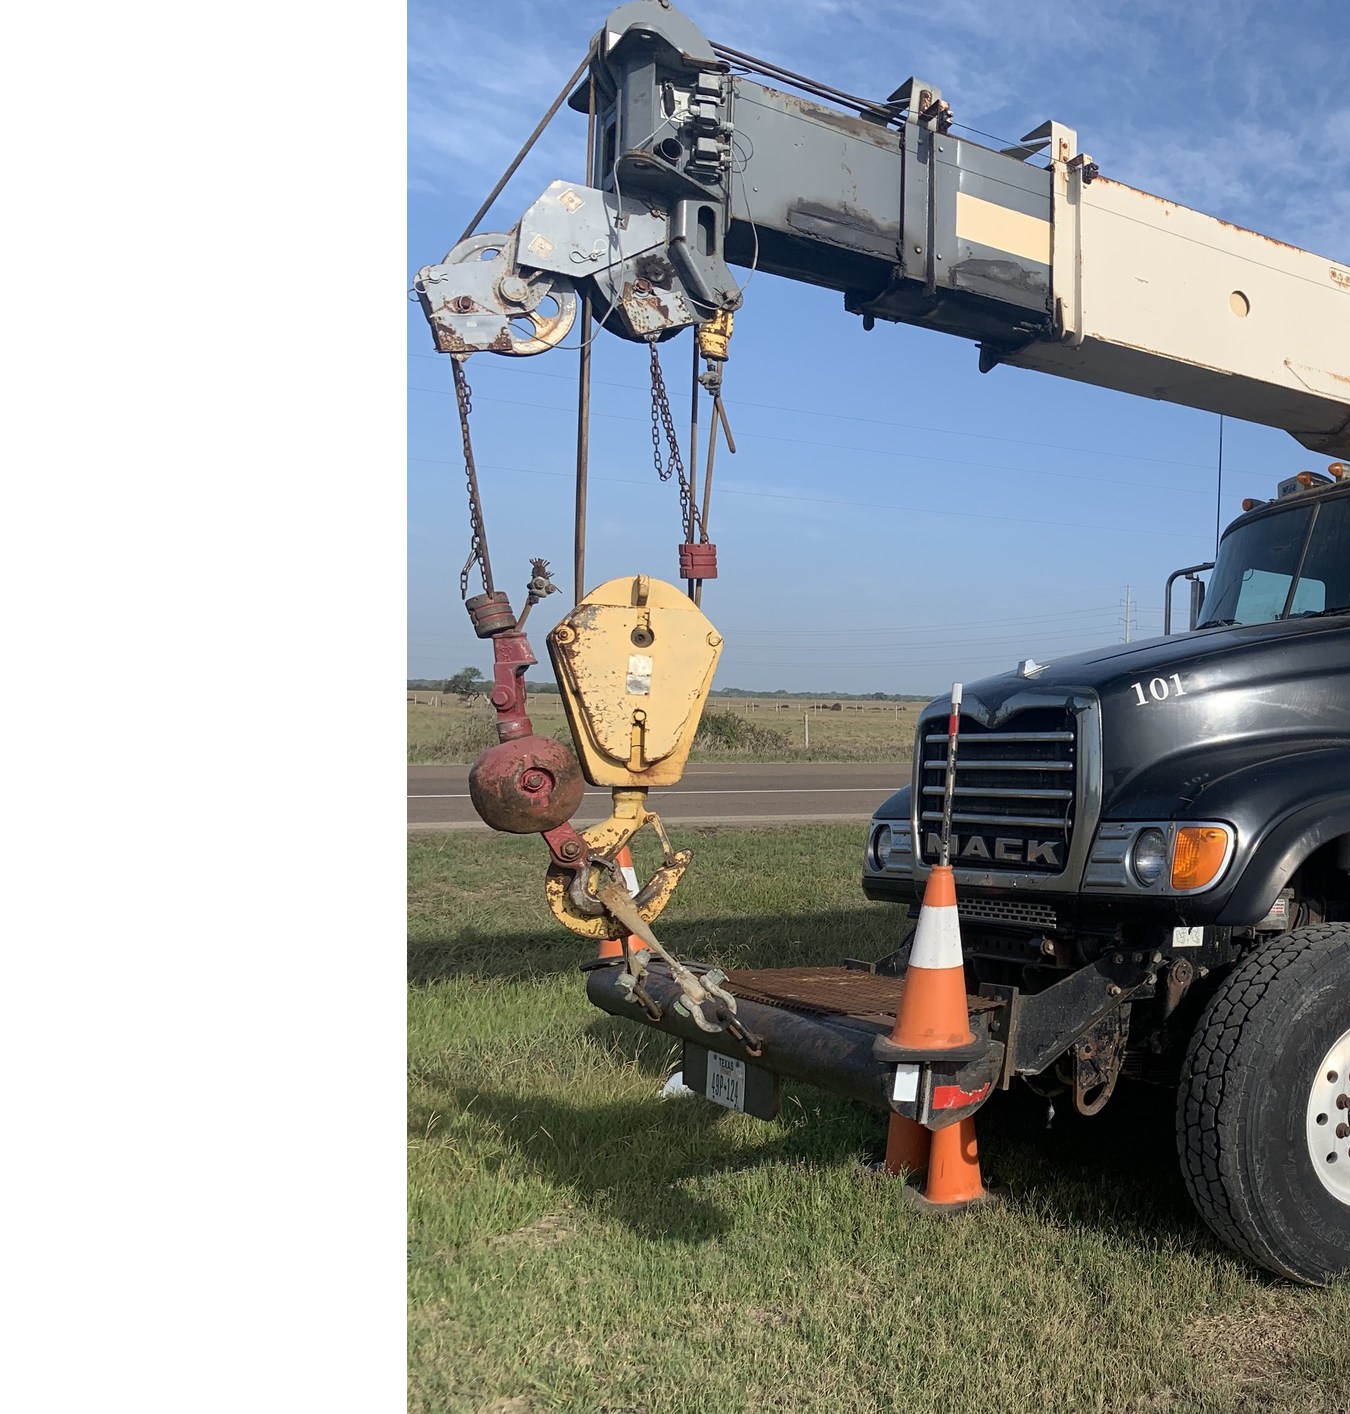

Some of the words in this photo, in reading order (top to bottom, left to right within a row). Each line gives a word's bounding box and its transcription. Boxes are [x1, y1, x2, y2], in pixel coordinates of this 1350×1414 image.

[1130, 673, 1187, 706] 101
[926, 832, 1061, 866] MACK
[718, 1057, 734, 1071] TEXAS
